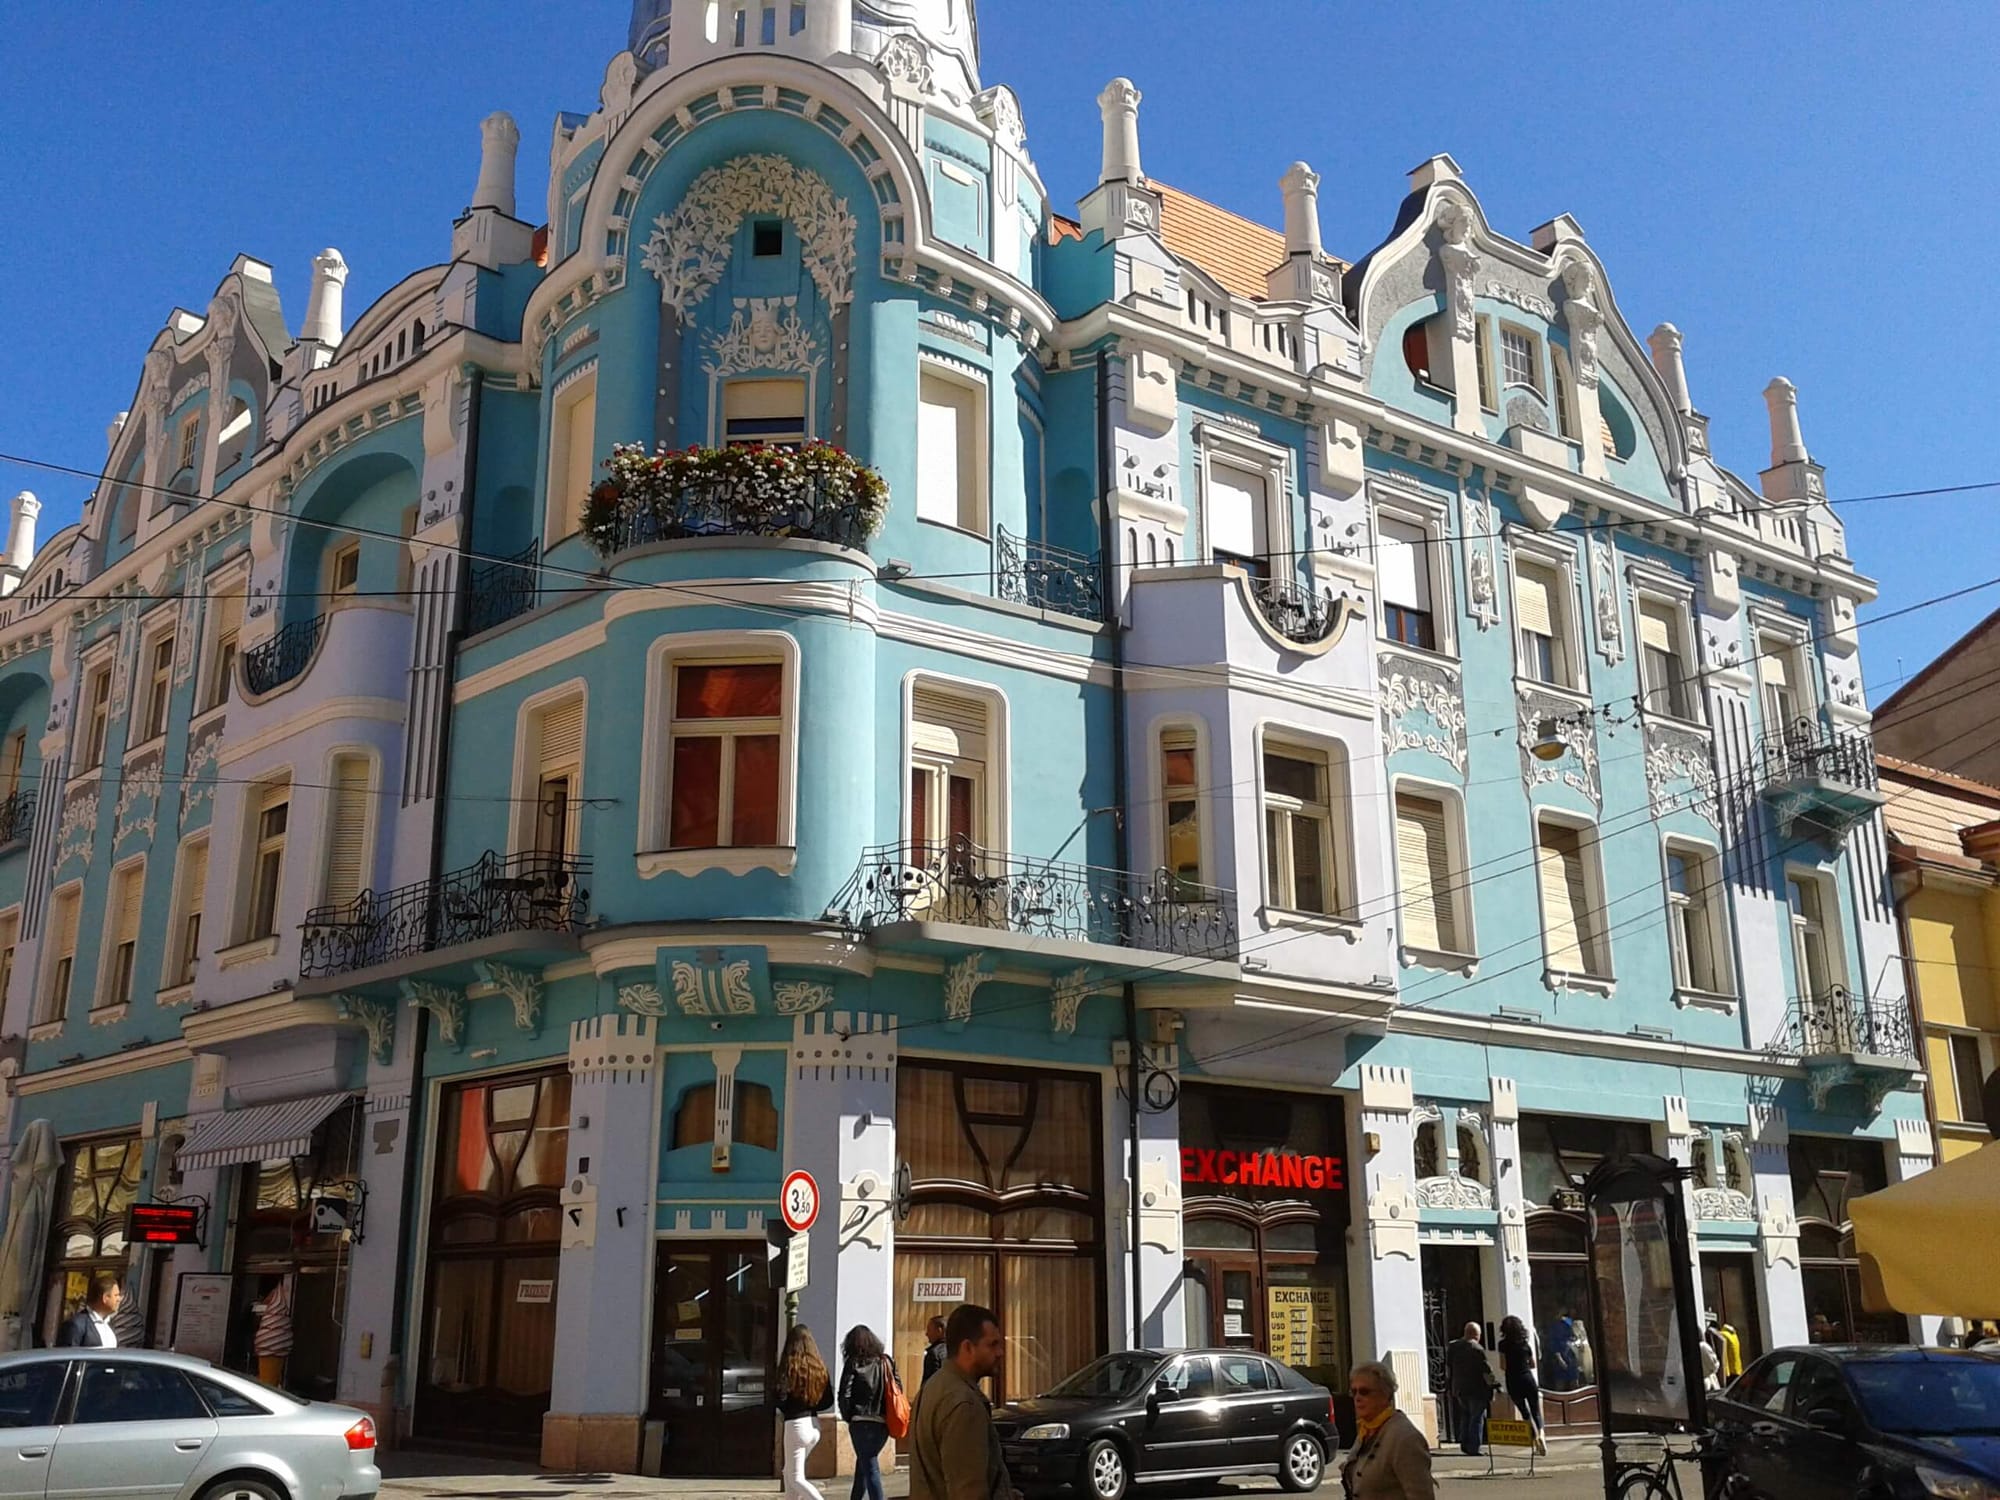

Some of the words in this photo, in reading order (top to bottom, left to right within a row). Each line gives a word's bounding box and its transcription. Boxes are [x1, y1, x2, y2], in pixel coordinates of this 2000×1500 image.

[1181, 1147, 1343, 1190] EXCHANGE
[917, 1282, 962, 1297] FRIZERIE
[1274, 1291, 1330, 1304] EXCHANGE
[1271, 1311, 1285, 1319] EUR
[1271, 1322, 1286, 1330] USD
[1271, 1333, 1285, 1341] GBP
[1272, 1344, 1285, 1352] CHF
